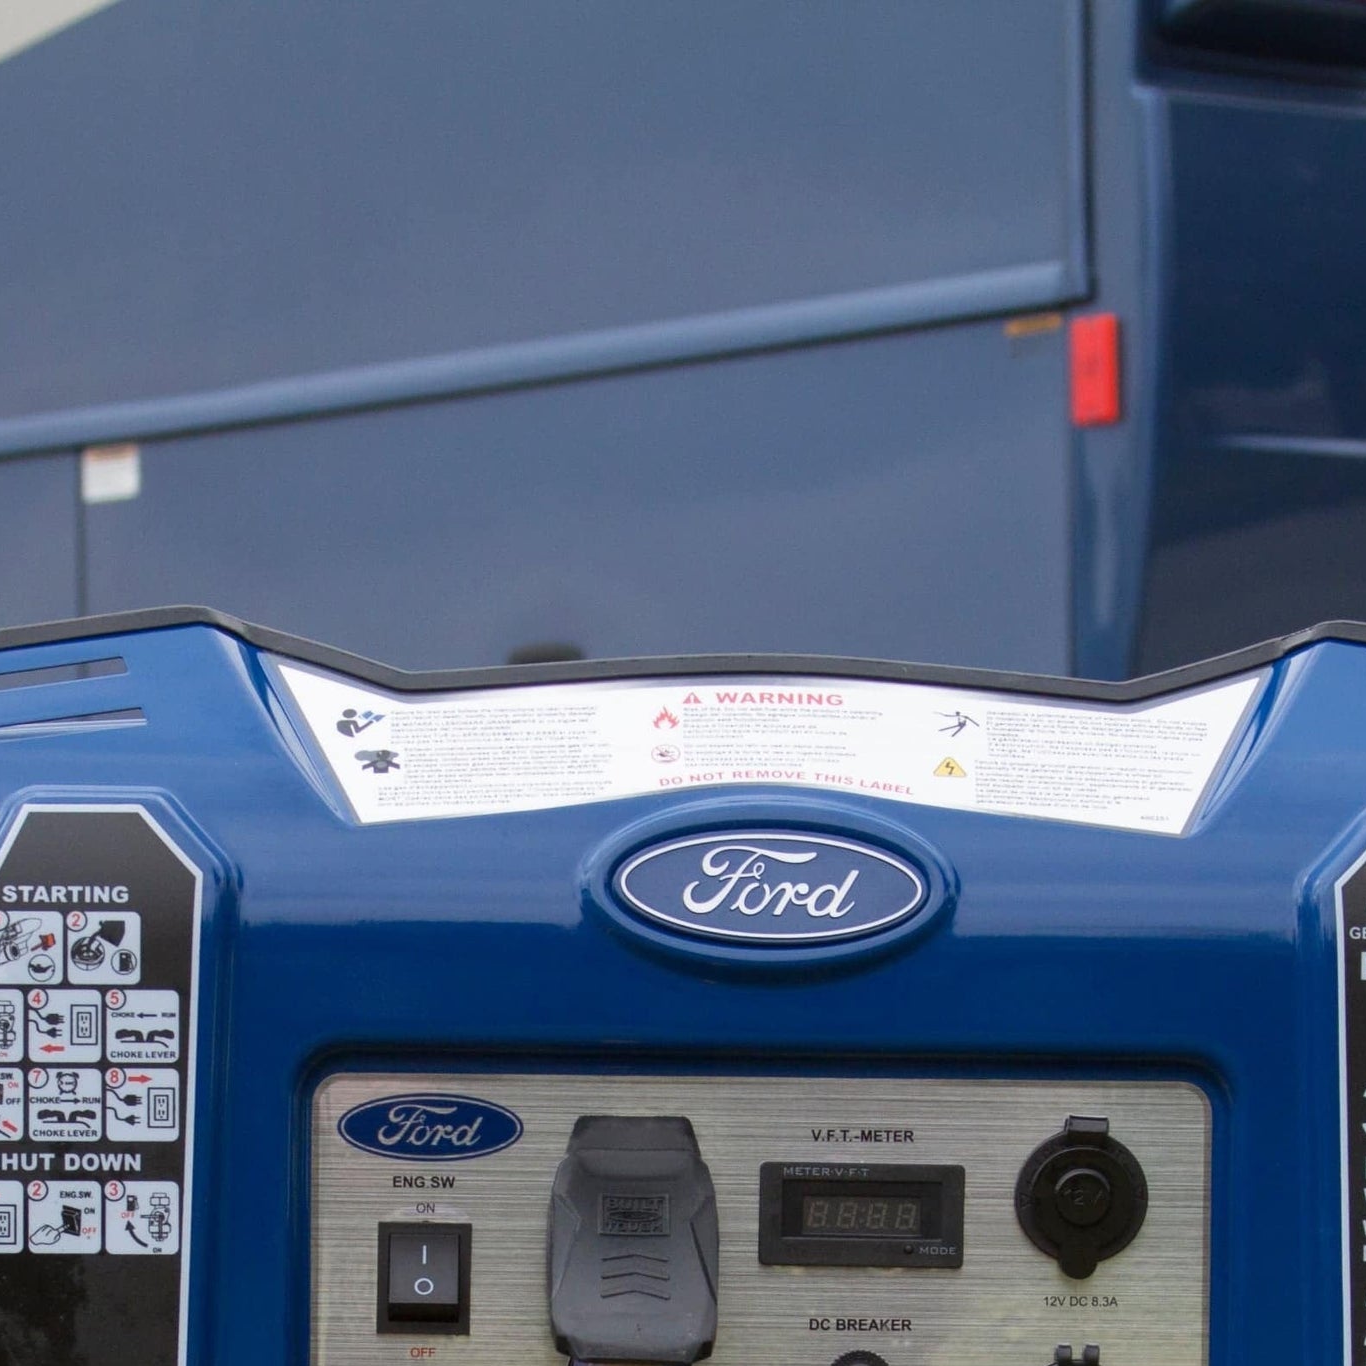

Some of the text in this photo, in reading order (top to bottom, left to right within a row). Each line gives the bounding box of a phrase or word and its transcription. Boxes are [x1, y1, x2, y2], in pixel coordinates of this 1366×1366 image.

[716, 692, 843, 706] WARNING
[659, 770, 914, 795] DO NOT REMOVE THIS LABEL
[682, 846, 860, 918] Ford
[2, 885, 129, 903] STARTING
[71, 914, 80, 927] 2
[31, 991, 41, 1004] 4
[110, 991, 119, 1004] 5
[110, 1051, 176, 1059] CHOKE LEVER
[33, 1071, 41, 1083] 7
[110, 1071, 119, 1083] 8
[8, 1081, 19, 1089] ON
[377, 1104, 484, 1146] Ford
[32, 1130, 98, 1138] CHOKE LEVER
[811, 1129, 914, 1143] V.F.T.-METER
[65, 1153, 142, 1172] DOWN
[32, 1184, 41, 1196] 2
[110, 1184, 119, 1196] 3
[84, 1207, 96, 1215] ON
[415, 1202, 435, 1214] ON
[81, 1227, 97, 1235] OFF
[918, 1246, 956, 1255] MODE
[1043, 1296, 1118, 1307] 12V DC 8.3A
[809, 1318, 912, 1331] DC BREAKER
[410, 1347, 436, 1358] OFF
